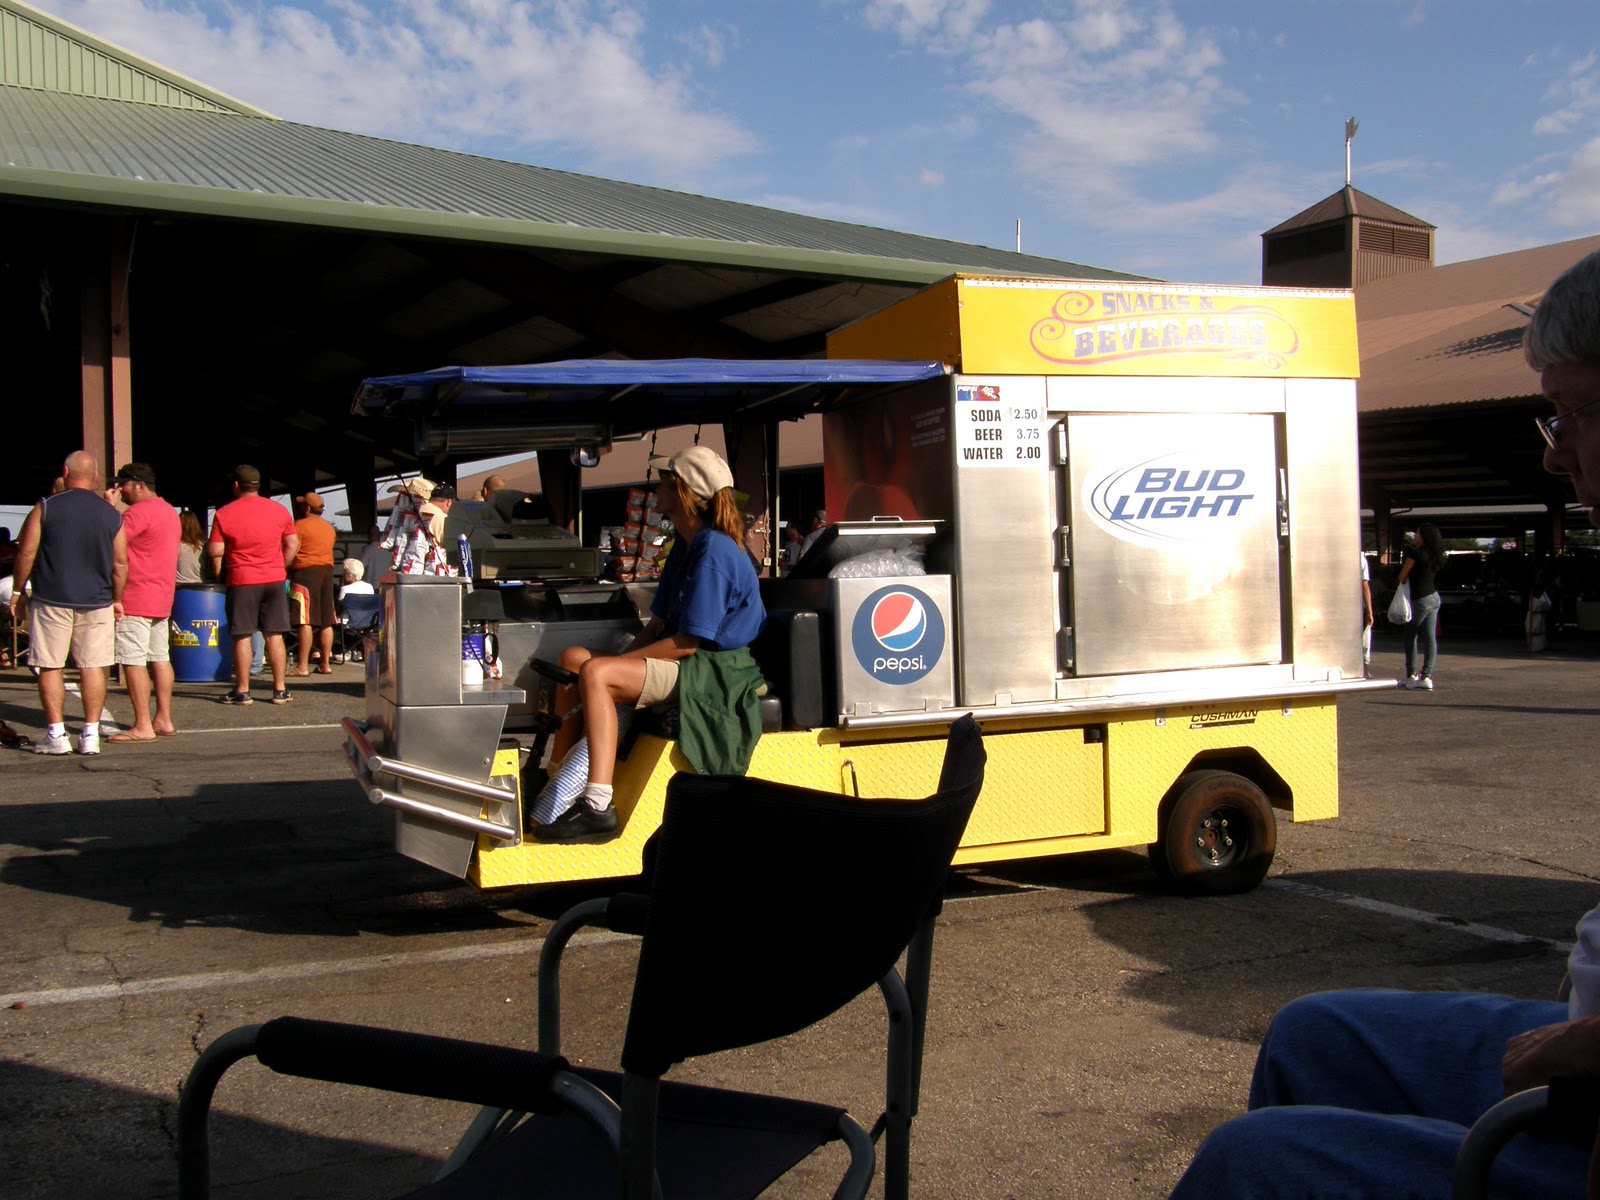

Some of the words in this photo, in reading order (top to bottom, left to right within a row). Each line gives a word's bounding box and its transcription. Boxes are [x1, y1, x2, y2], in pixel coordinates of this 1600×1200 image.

[1102, 292, 1190, 316] SNACKS
[1199, 296, 1217, 311] &
[1073, 318, 1267, 358] BEVERAGES
[971, 409, 1002, 422] SODA
[1014, 408, 1038, 420] 2.50
[975, 428, 1003, 441] BEER
[1016, 428, 1040, 440] 3.75
[963, 447, 1003, 460] WATER
[1016, 446, 1041, 459] 2.00
[1134, 467, 1246, 493] BUD
[1109, 494, 1255, 521] LIGHT
[873, 654, 924, 674] pepsi
[1191, 709, 1259, 723] CUSHMAN
